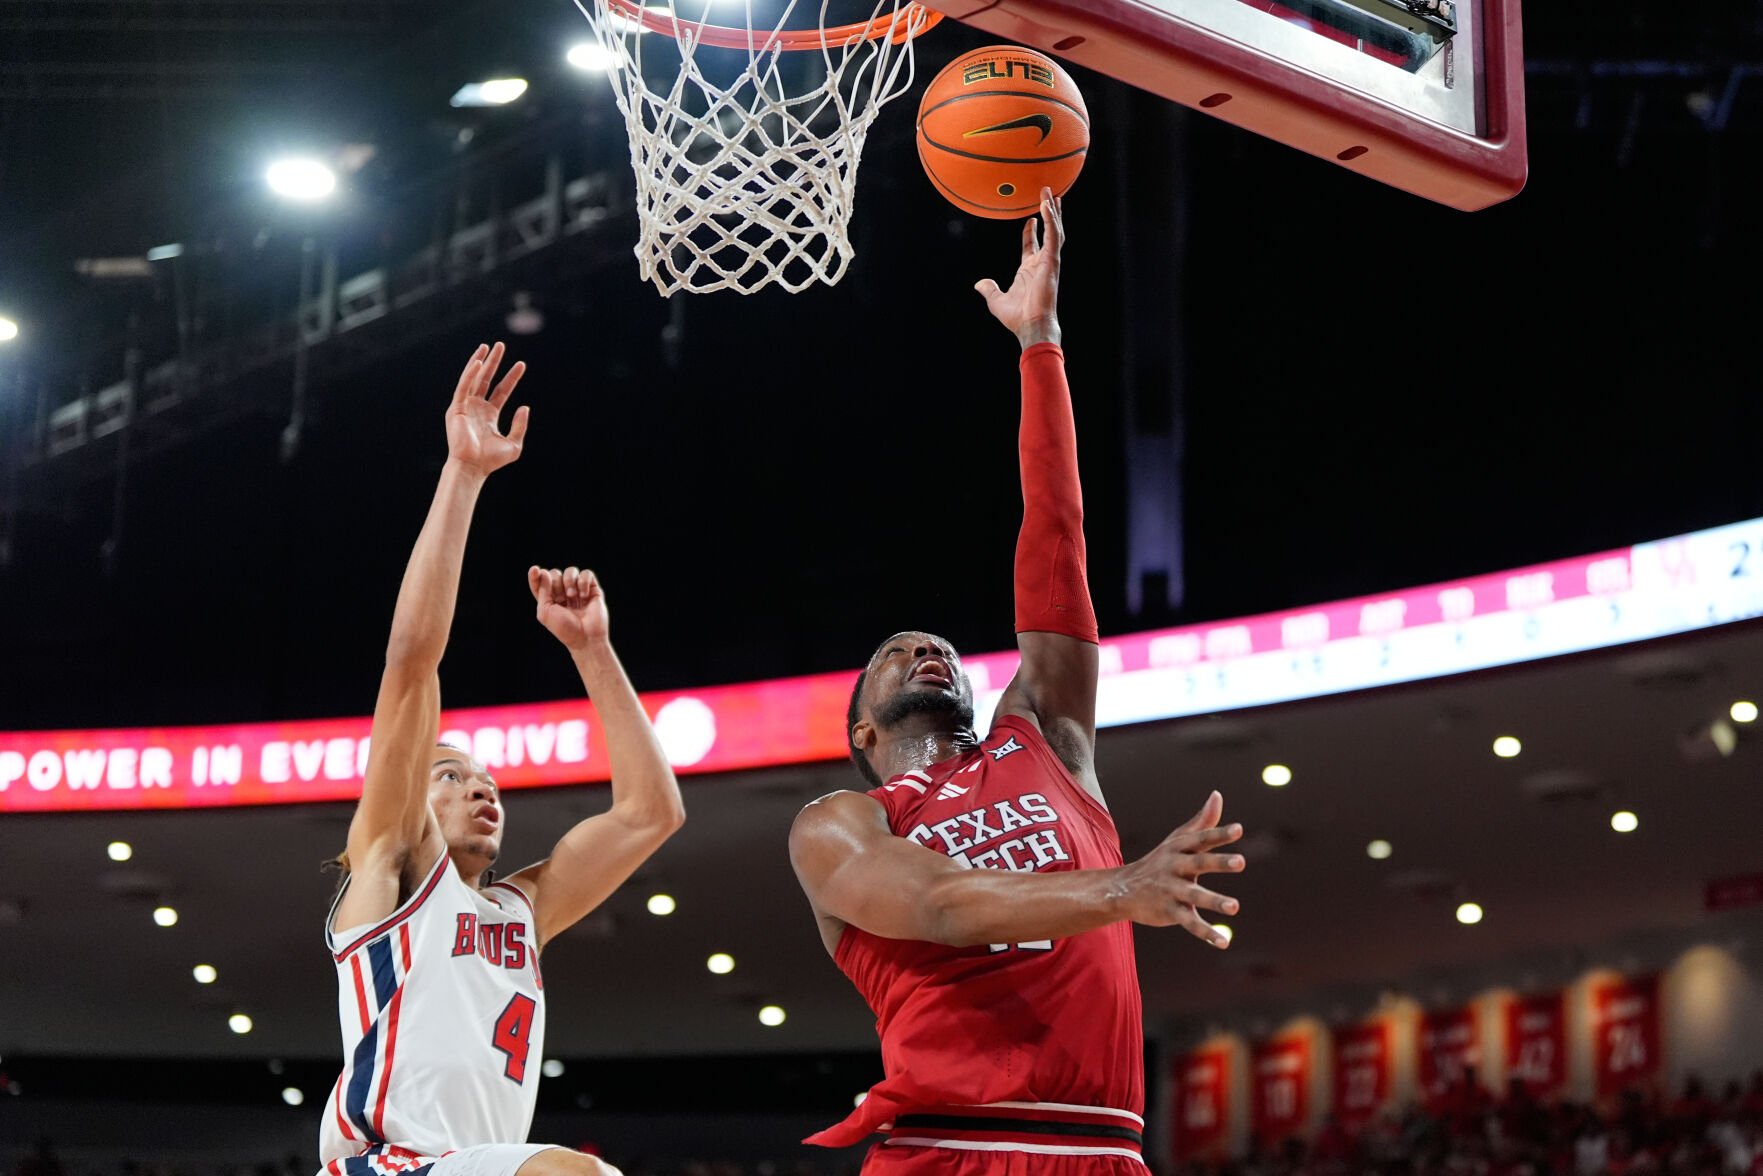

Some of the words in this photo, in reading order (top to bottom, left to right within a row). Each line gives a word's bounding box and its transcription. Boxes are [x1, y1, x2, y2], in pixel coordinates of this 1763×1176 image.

[963, 60, 1054, 89] ELITE
[0, 746, 173, 793] POWER
[191, 745, 243, 786] IN
[260, 736, 372, 783] EVE
[492, 991, 537, 1086] 4
